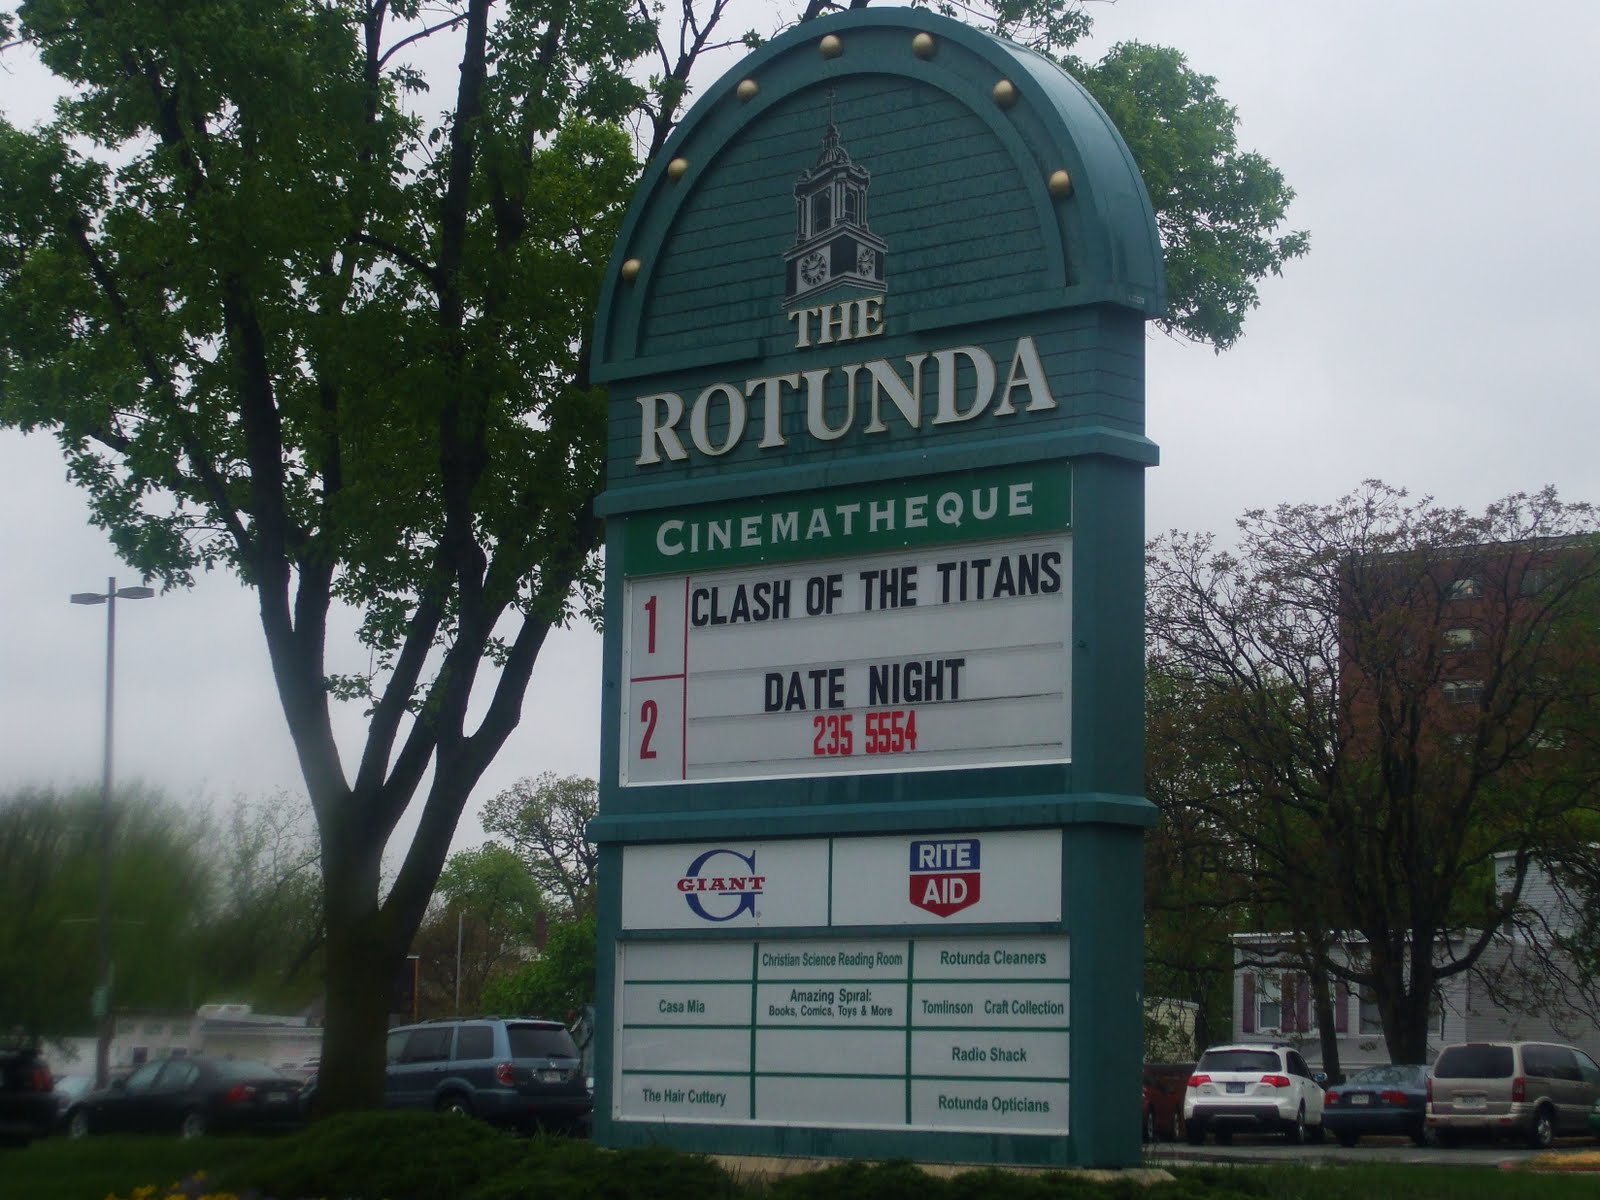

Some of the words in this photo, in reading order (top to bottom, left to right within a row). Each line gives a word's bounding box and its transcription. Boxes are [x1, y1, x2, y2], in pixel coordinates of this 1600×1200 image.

[788, 295, 885, 348] THE
[635, 336, 1057, 466] ROTUNDA
[656, 482, 1034, 557] CINEMATHEQUE
[691, 579, 791, 627] CLASH
[806, 574, 843, 616] OF
[860, 566, 917, 611] THE
[937, 551, 1062, 603] TITANS
[644, 595, 657, 654] 1
[764, 668, 845, 712] DATE
[869, 658, 965, 706] NIGHT
[640, 700, 658, 760] 2
[813, 714, 853, 756] 235
[865, 710, 917, 753] 5554
[918, 843, 971, 869] RITE
[677, 876, 765, 892] GIANT
[922, 877, 968, 905] AID
[762, 953, 800, 967] Christian
[802, 952, 836, 966] Science
[838, 952, 874, 969] Reading
[876, 951, 903, 966] Room
[940, 951, 990, 965] Rotunda
[993, 950, 1047, 965] Cleaners
[659, 999, 684, 1013] Casa
[687, 1000, 705, 1013] Mia
[790, 988, 834, 1005] Amazing
[839, 988, 872, 1005] Spiral:
[922, 1000, 973, 1014] Tomlinson
[984, 1000, 1009, 1014] Craft
[1011, 1000, 1064, 1015] Collection
[769, 1005, 798, 1018] Books,
[801, 1005, 835, 1017] Comics,
[838, 1005, 857, 1018] Toys
[861, 1006, 867, 1016] &
[871, 1005, 893, 1016] More
[952, 1047, 986, 1062] Radio
[990, 1047, 1027, 1062] Shack
[643, 1088, 661, 1102] The
[664, 1089, 685, 1103] Hair
[688, 1089, 726, 1107] Cuttery
[938, 1095, 988, 1111] Rotunda
[992, 1096, 1050, 1114] Opticians
